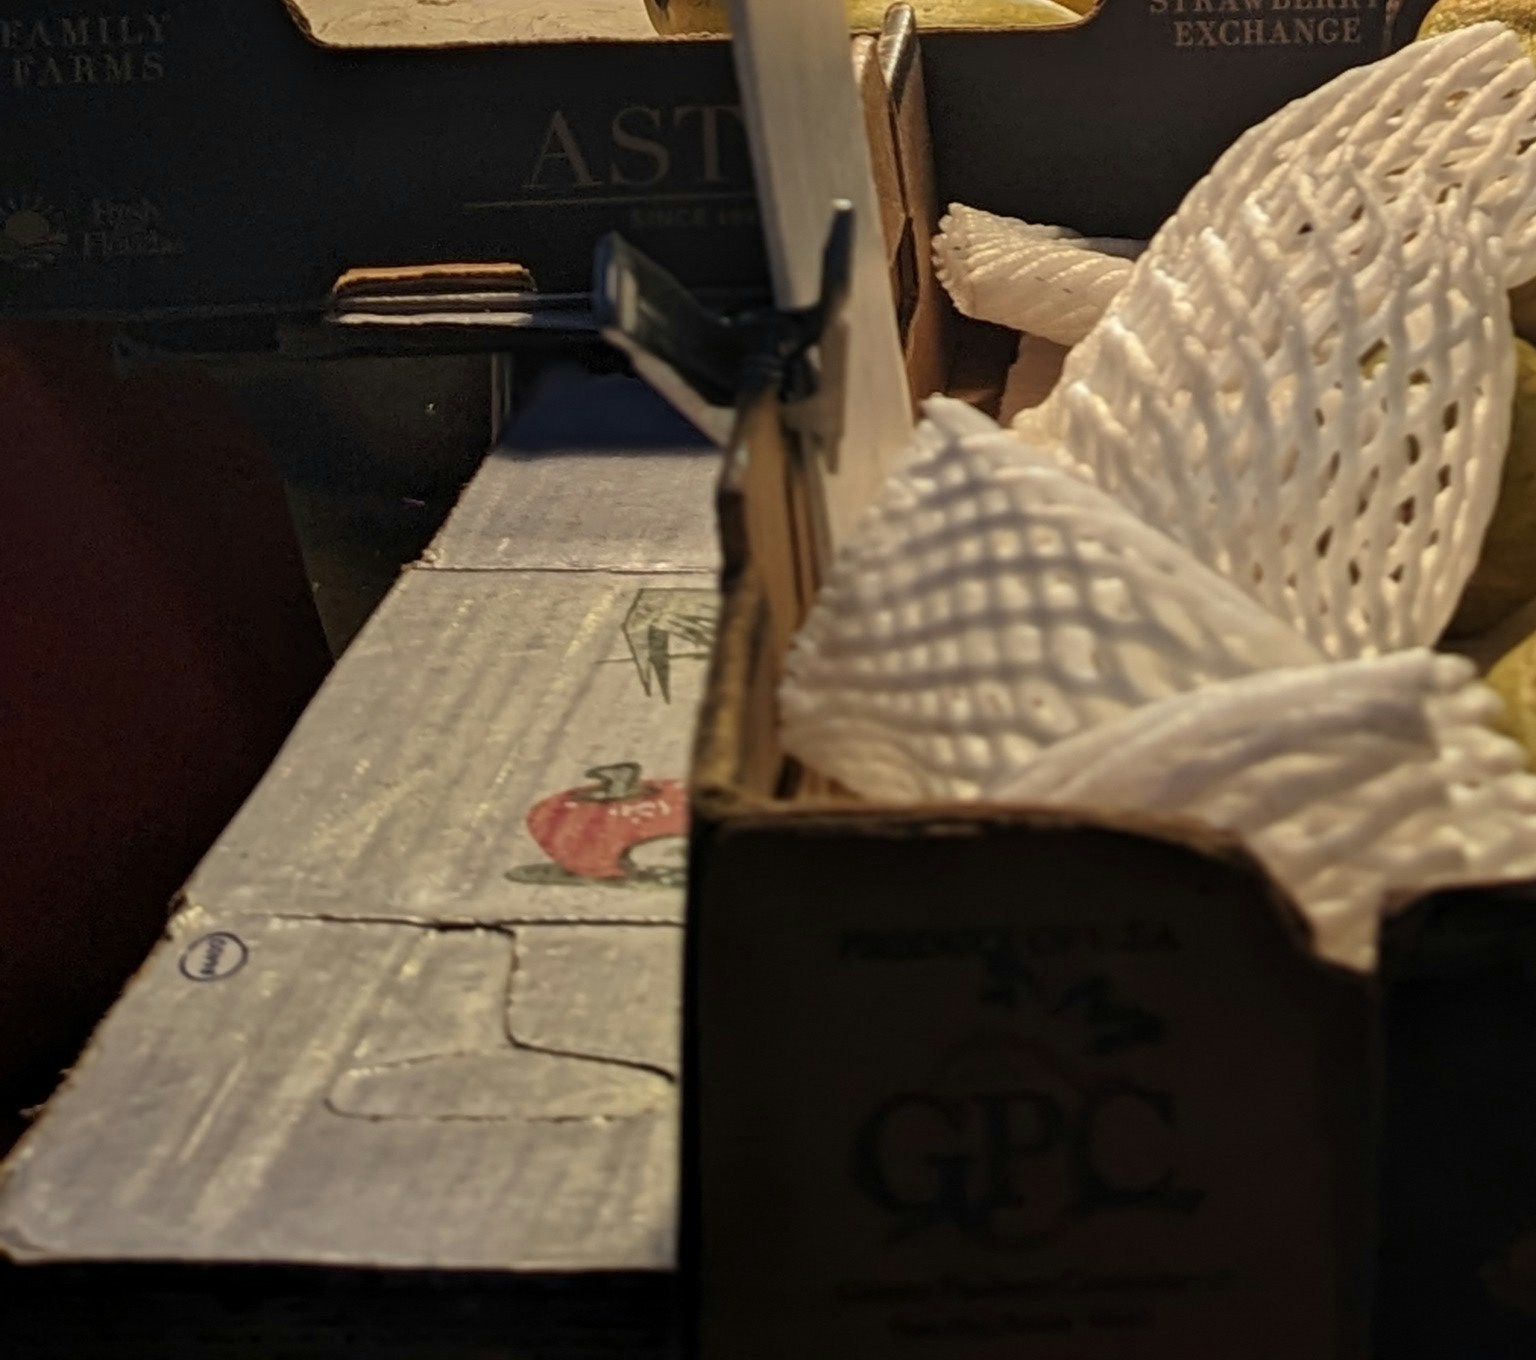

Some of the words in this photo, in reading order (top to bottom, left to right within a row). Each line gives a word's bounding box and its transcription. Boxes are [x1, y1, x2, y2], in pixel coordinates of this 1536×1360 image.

[0, 13, 171, 48] FAMILY
[1173, 17, 1362, 48] EXCHANGE
[12, 51, 165, 89] FARMS
[521, 103, 748, 189] AST
[850, 1077, 1207, 1225] GPC
